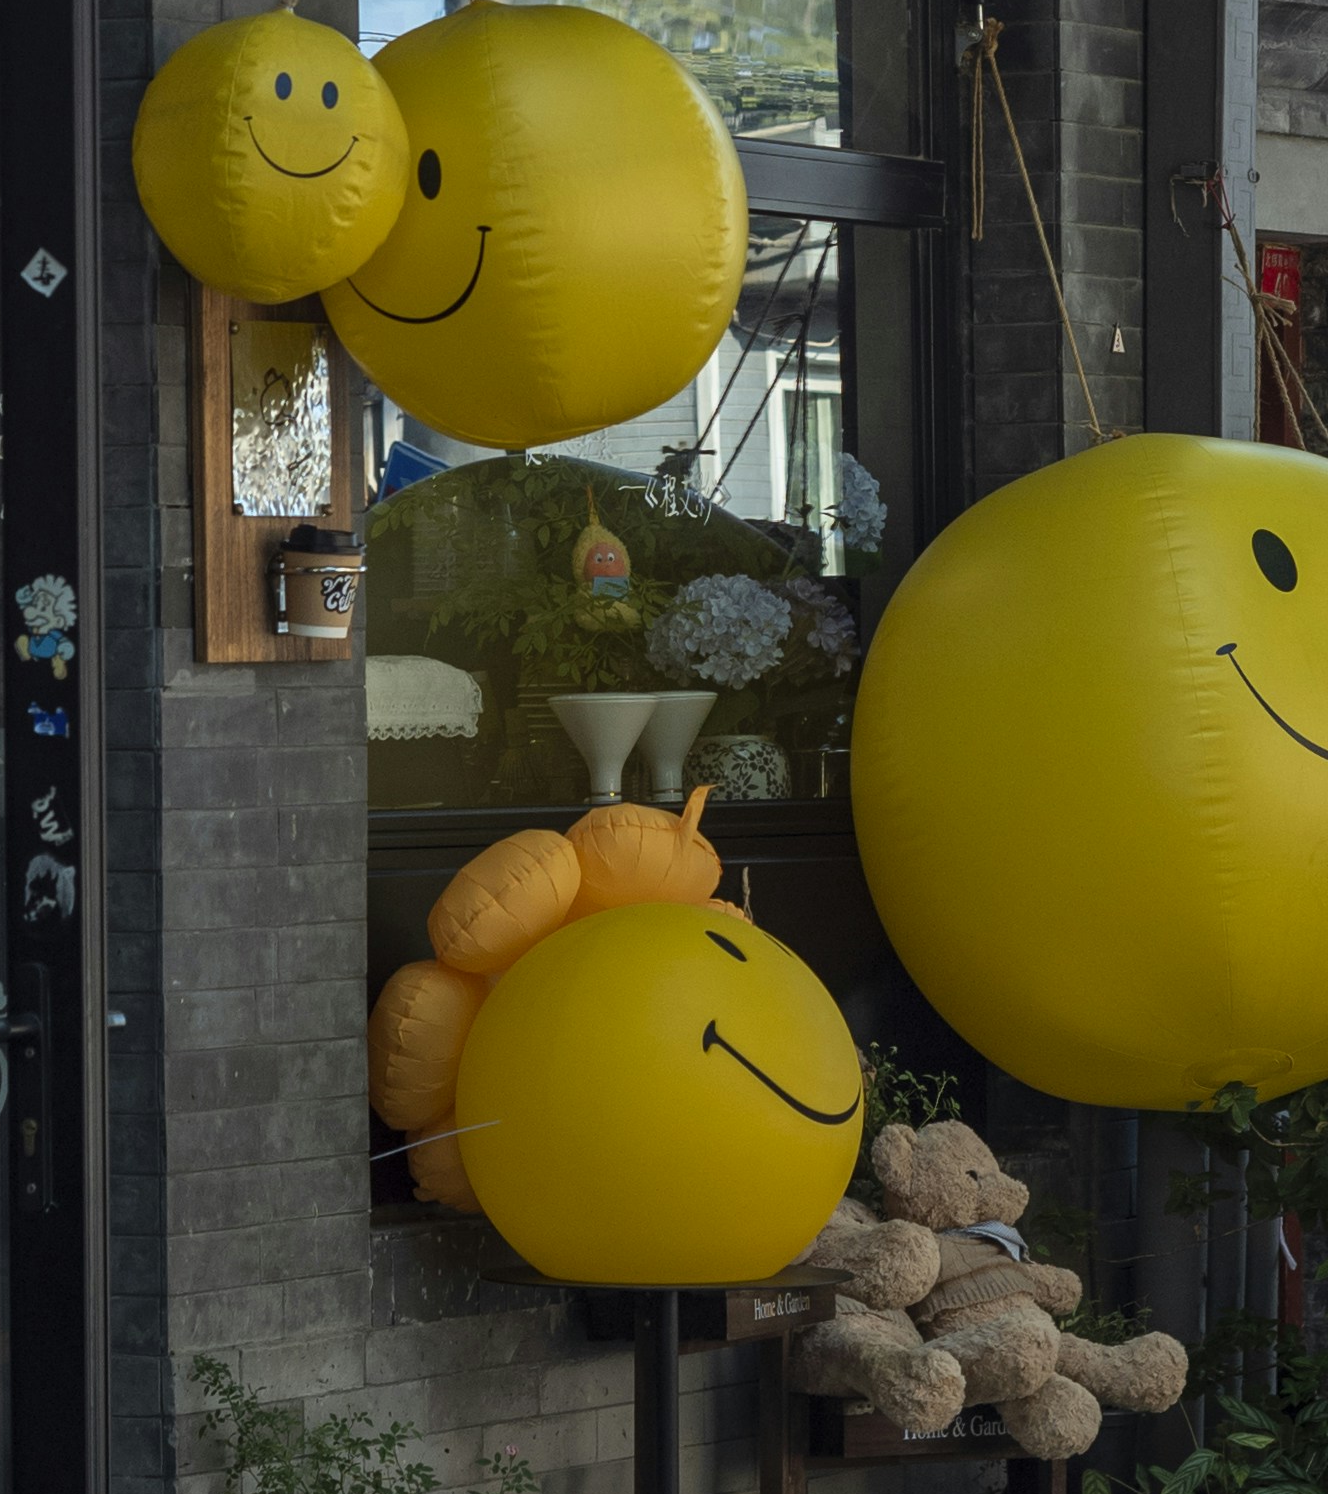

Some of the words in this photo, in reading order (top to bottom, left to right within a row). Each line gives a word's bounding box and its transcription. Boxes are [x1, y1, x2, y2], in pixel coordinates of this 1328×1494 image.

[754, 1298, 776, 1321] Home
[776, 1293, 785, 1316] &
[784, 1292, 810, 1315] Garden
[952, 1416, 967, 1439] &
